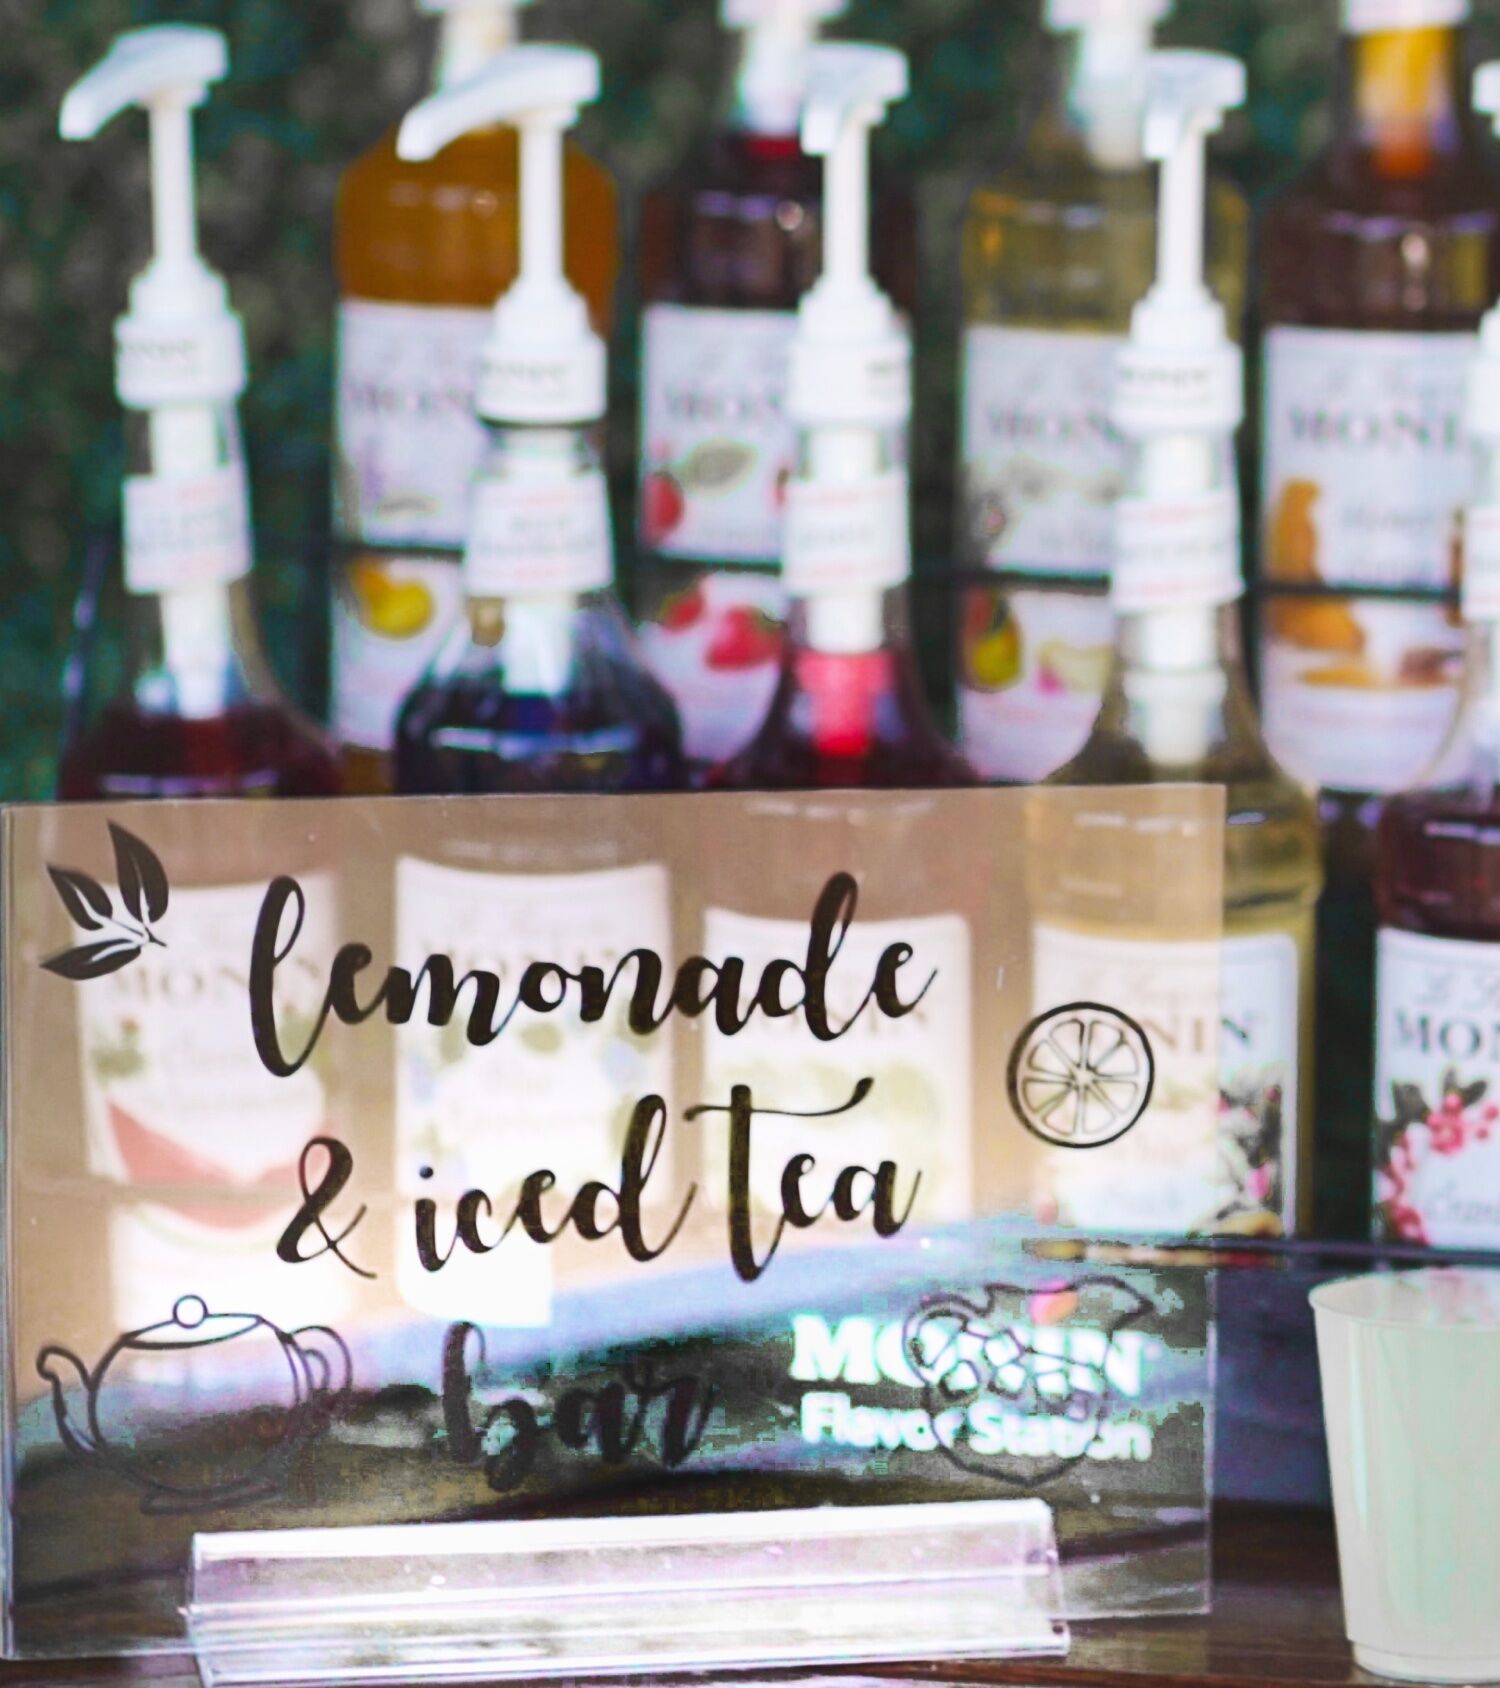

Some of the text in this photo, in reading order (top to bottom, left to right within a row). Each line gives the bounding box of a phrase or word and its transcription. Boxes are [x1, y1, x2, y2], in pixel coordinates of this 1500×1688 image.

[249, 874, 937, 1078] lemonade
[276, 1076, 922, 1283] & iced tea
[442, 1320, 714, 1493] bar
